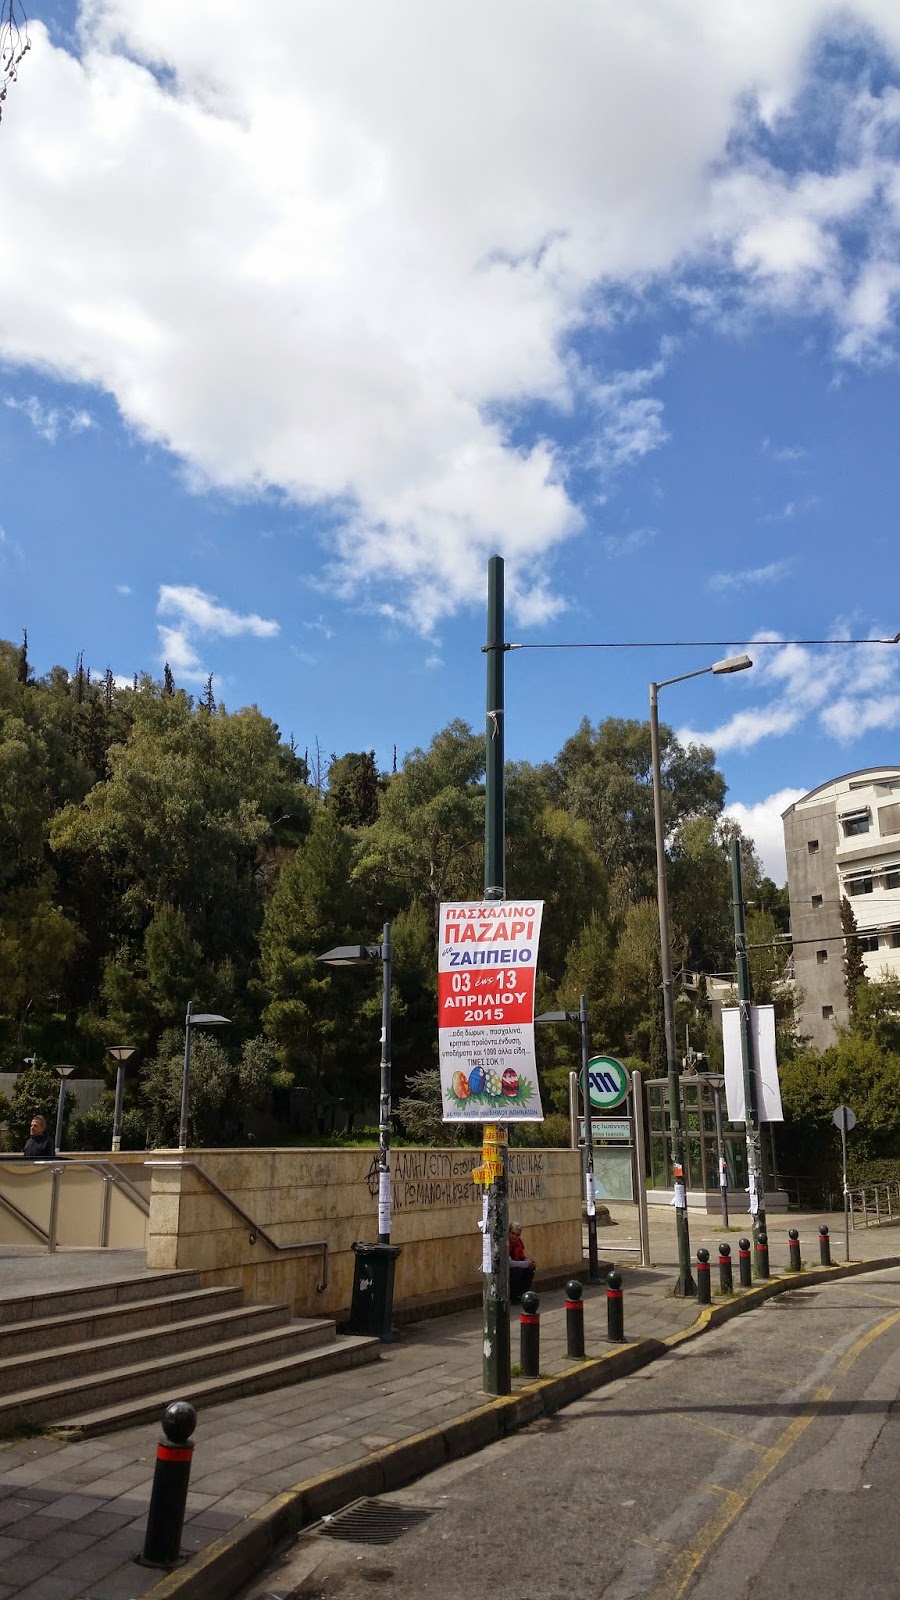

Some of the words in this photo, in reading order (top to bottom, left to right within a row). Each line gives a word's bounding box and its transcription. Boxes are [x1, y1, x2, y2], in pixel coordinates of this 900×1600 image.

[446, 907, 536, 920] ΠΑΣΧΑΛΙΝΟ
[445, 921, 534, 944] ΠΑΖΑΡΙ
[449, 948, 532, 966] ΖΑΠΠΕΙΟ
[452, 972, 471, 992] 03
[496, 970, 517, 990] 13
[444, 992, 527, 1008] ΑΠΡΙΛΙΟΥ
[464, 1008, 504, 1022] 2015
[483, 1048, 497, 1056] 1000
[467, 1058, 485, 1066] ΤΙΜΕΣ
[486, 1058, 499, 1066] ΣΟΚ
